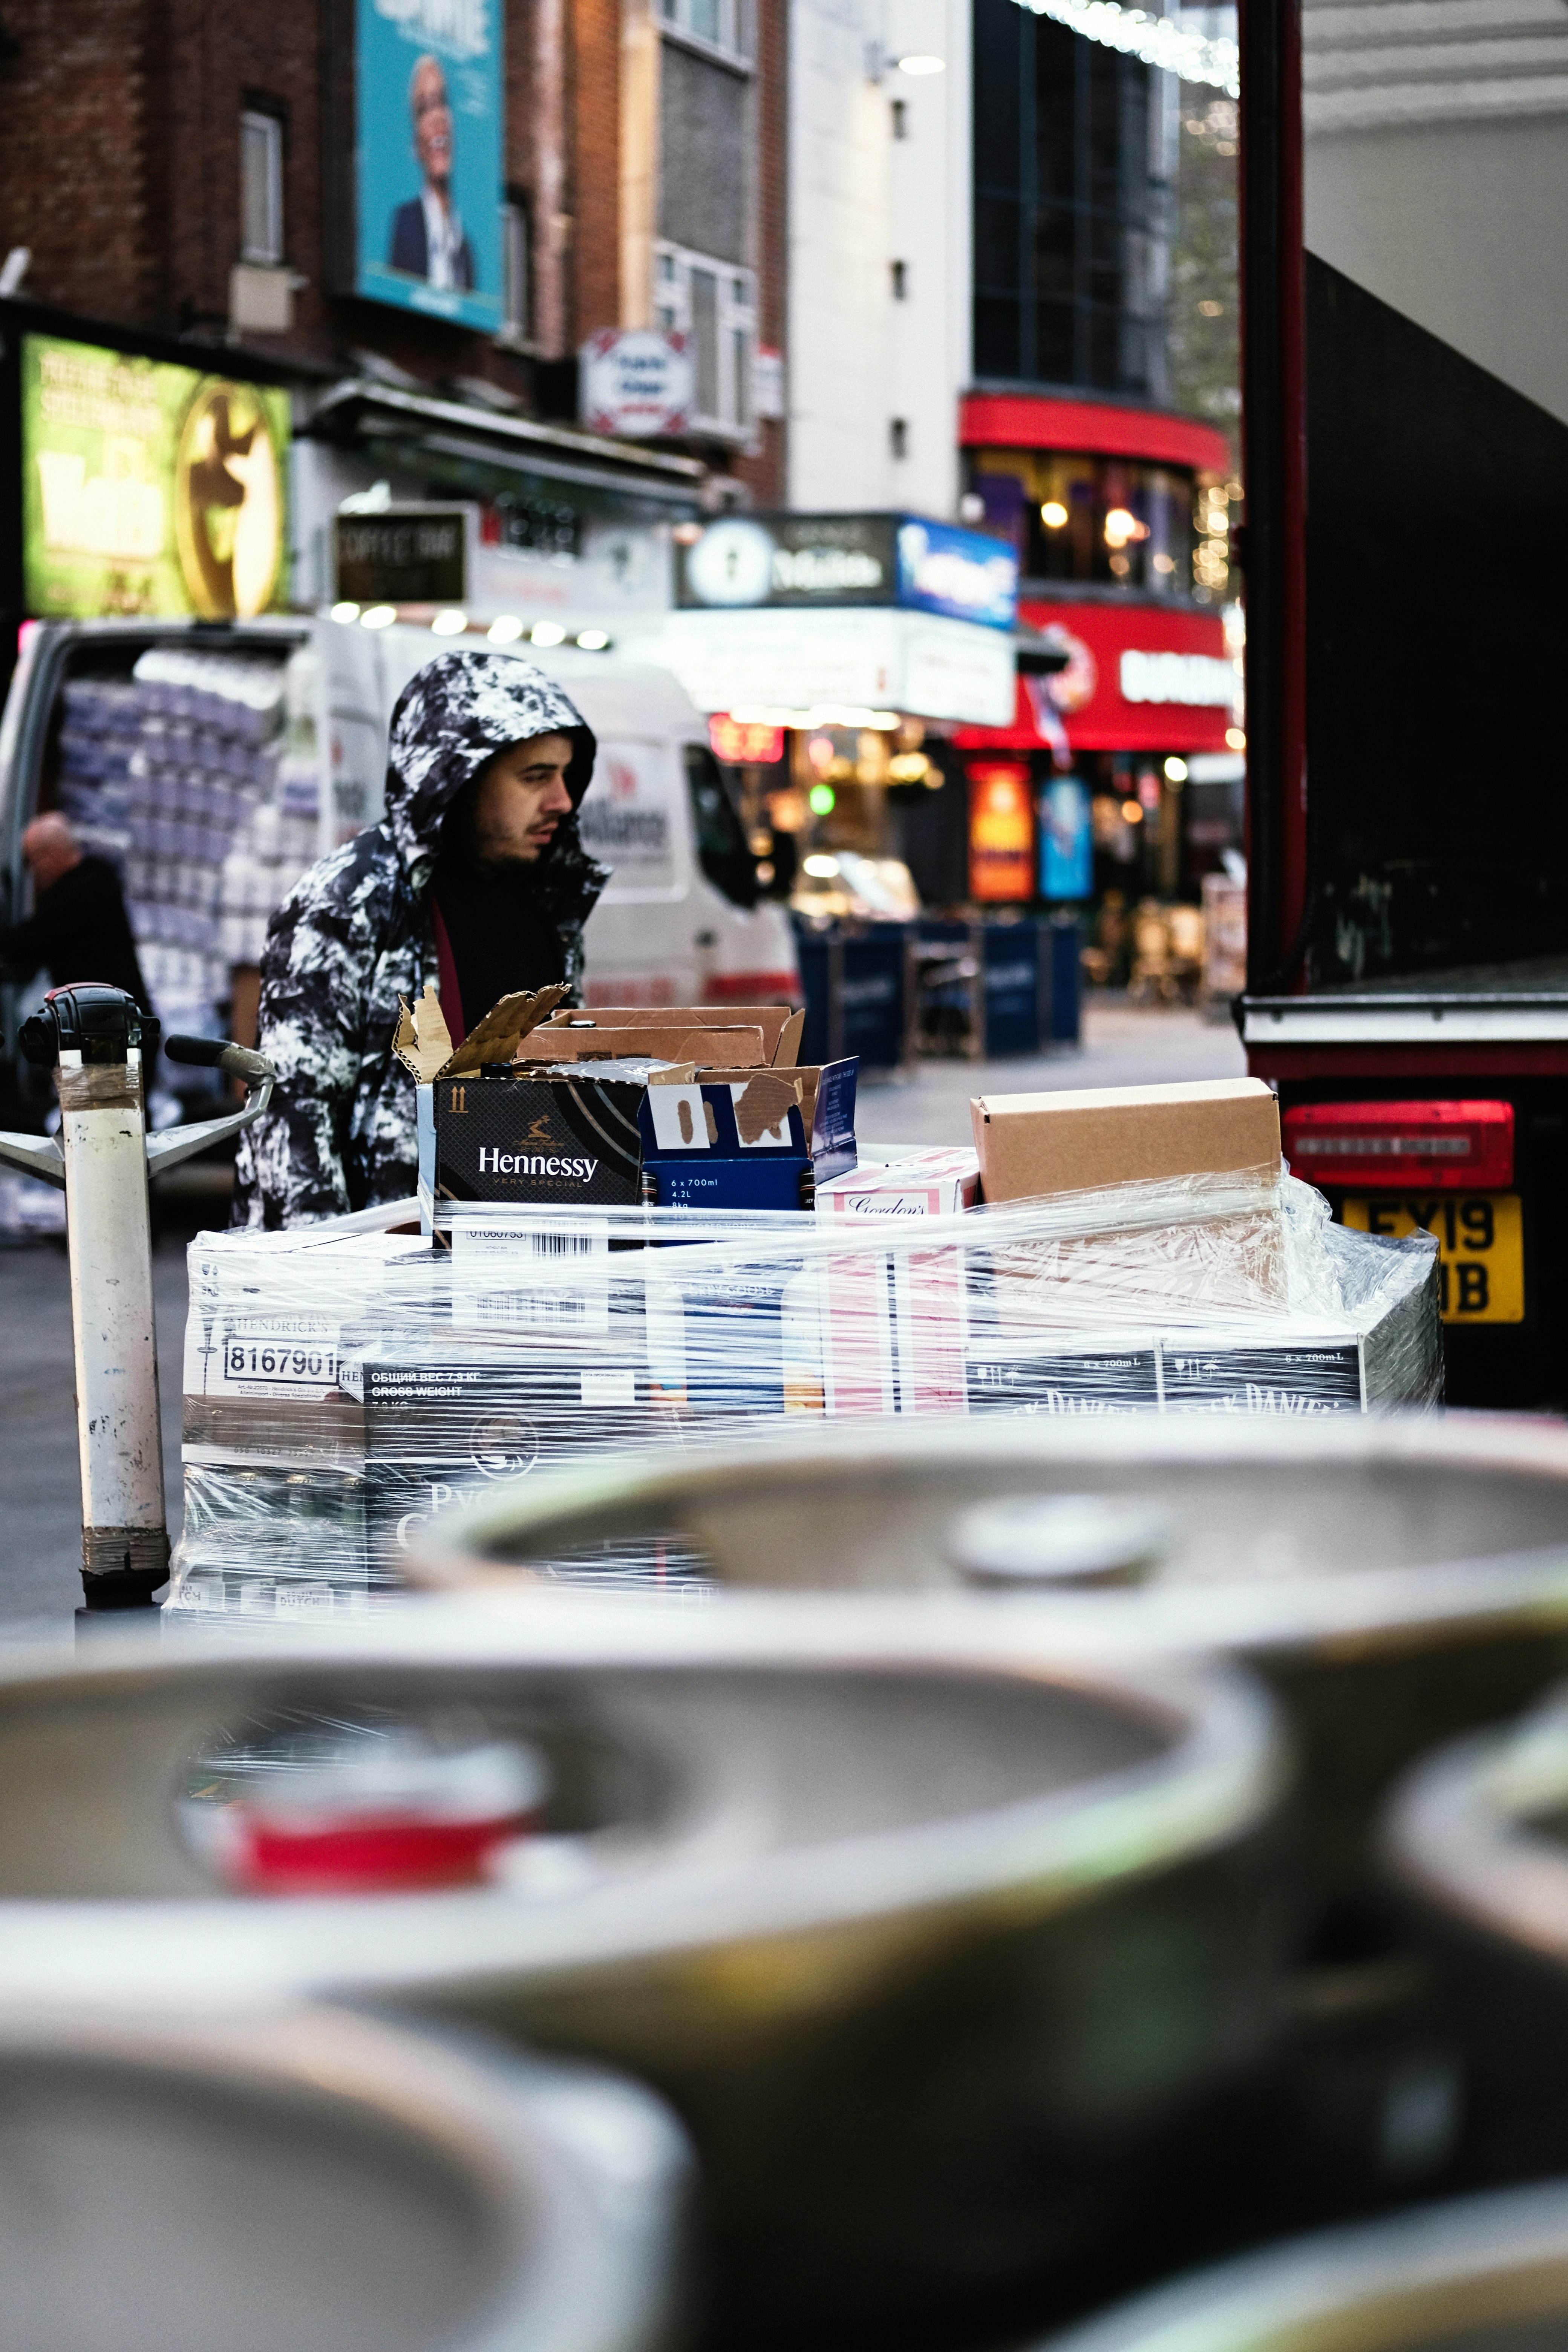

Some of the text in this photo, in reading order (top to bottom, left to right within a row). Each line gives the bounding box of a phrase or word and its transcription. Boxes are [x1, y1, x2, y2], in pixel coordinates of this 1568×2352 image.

[479, 1147, 599, 1182] Hennessy
[849, 1197, 923, 1214] Gordon's
[237, 1320, 330, 1333] HENDRICK'S
[231, 1346, 333, 1376] 8167901
[1103, 1358, 1140, 1367] 700mL
[1306, 1353, 1344, 1361] 700mL
[371, 1371, 480, 1384] ОБЩИЙ ВЕС 7,9 КГ
[372, 1387, 462, 1397] GROSS WEIGHT
[280, 1597, 320, 1606] DUTCH
